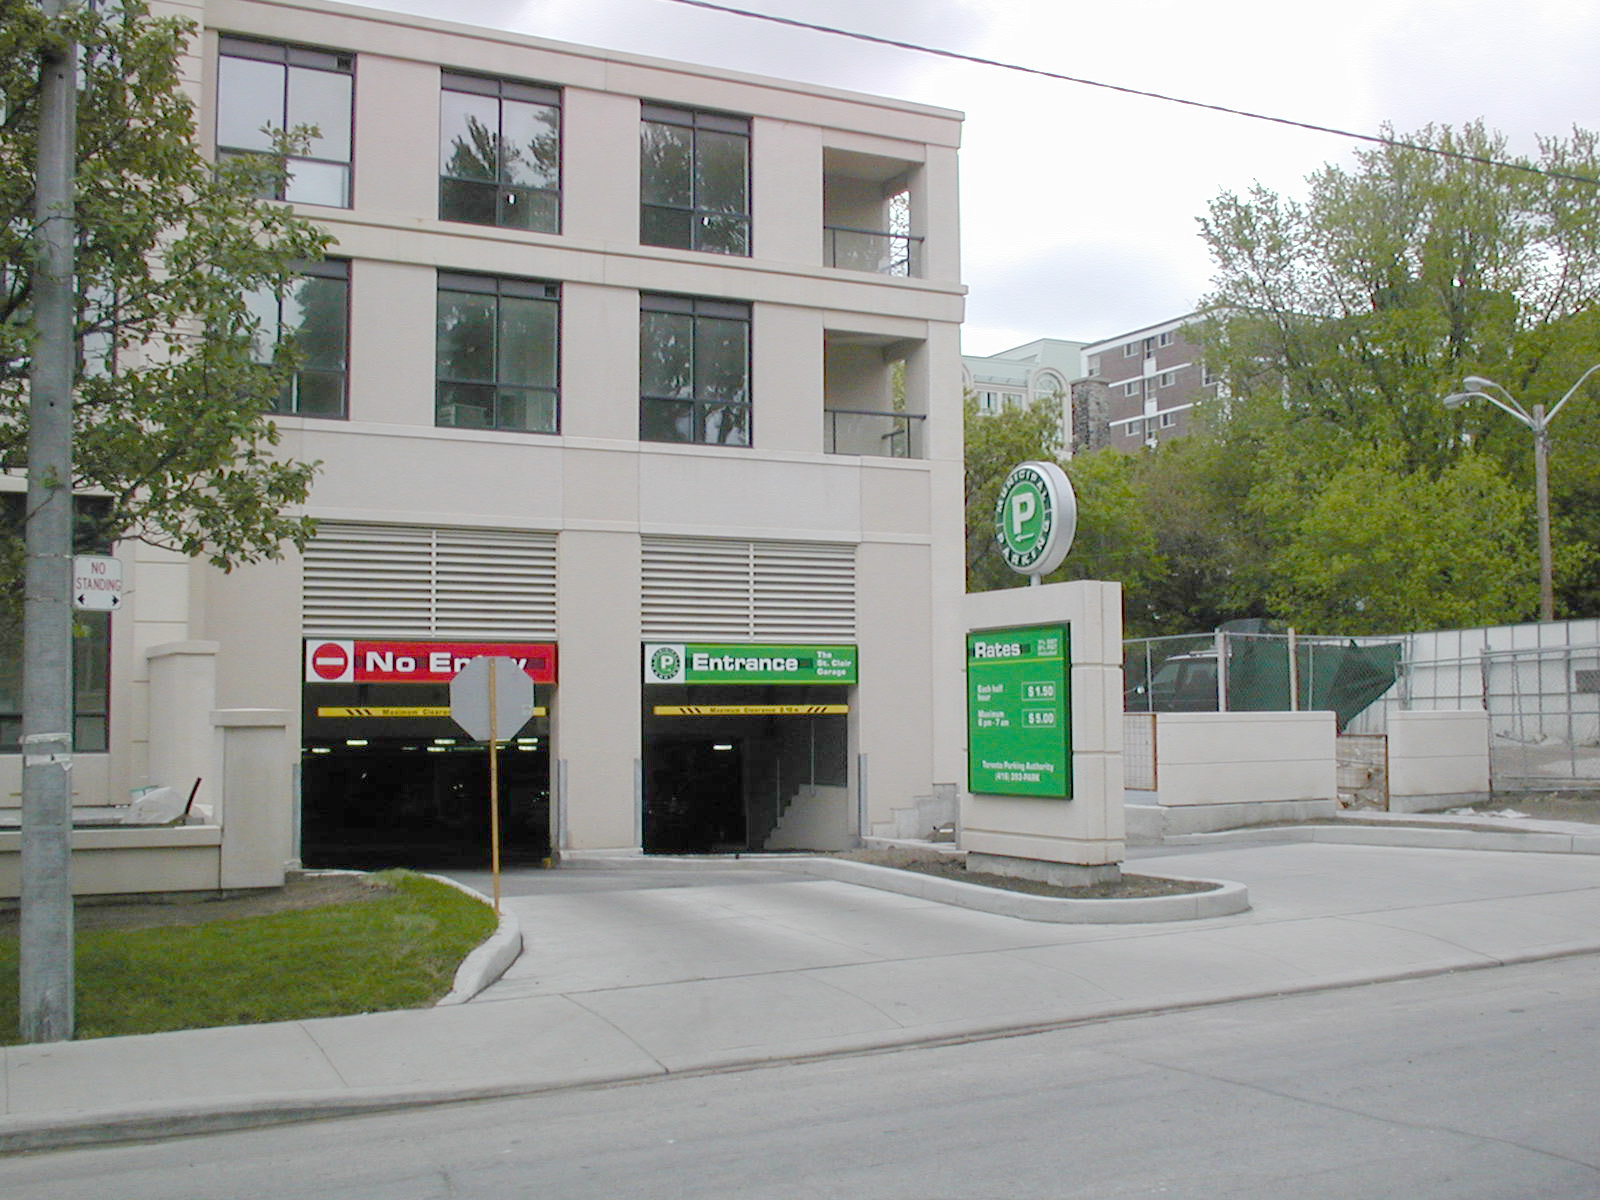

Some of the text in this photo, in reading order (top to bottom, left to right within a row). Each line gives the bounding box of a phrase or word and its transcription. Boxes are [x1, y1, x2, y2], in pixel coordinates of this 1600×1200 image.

[996, 468, 1049, 513] MUNICIPAL
[1011, 492, 1036, 535] P
[996, 519, 1051, 567] PARKING
[91, 562, 106, 575] NO
[75, 577, 121, 592] STANDING
[816, 650, 833, 658] The
[974, 641, 1021, 659] Rates
[366, 651, 416, 673] No
[660, 654, 674, 670] P
[692, 652, 799, 672] Entrance
[816, 658, 852, 667] St. Clair
[816, 667, 847, 677] Garage
